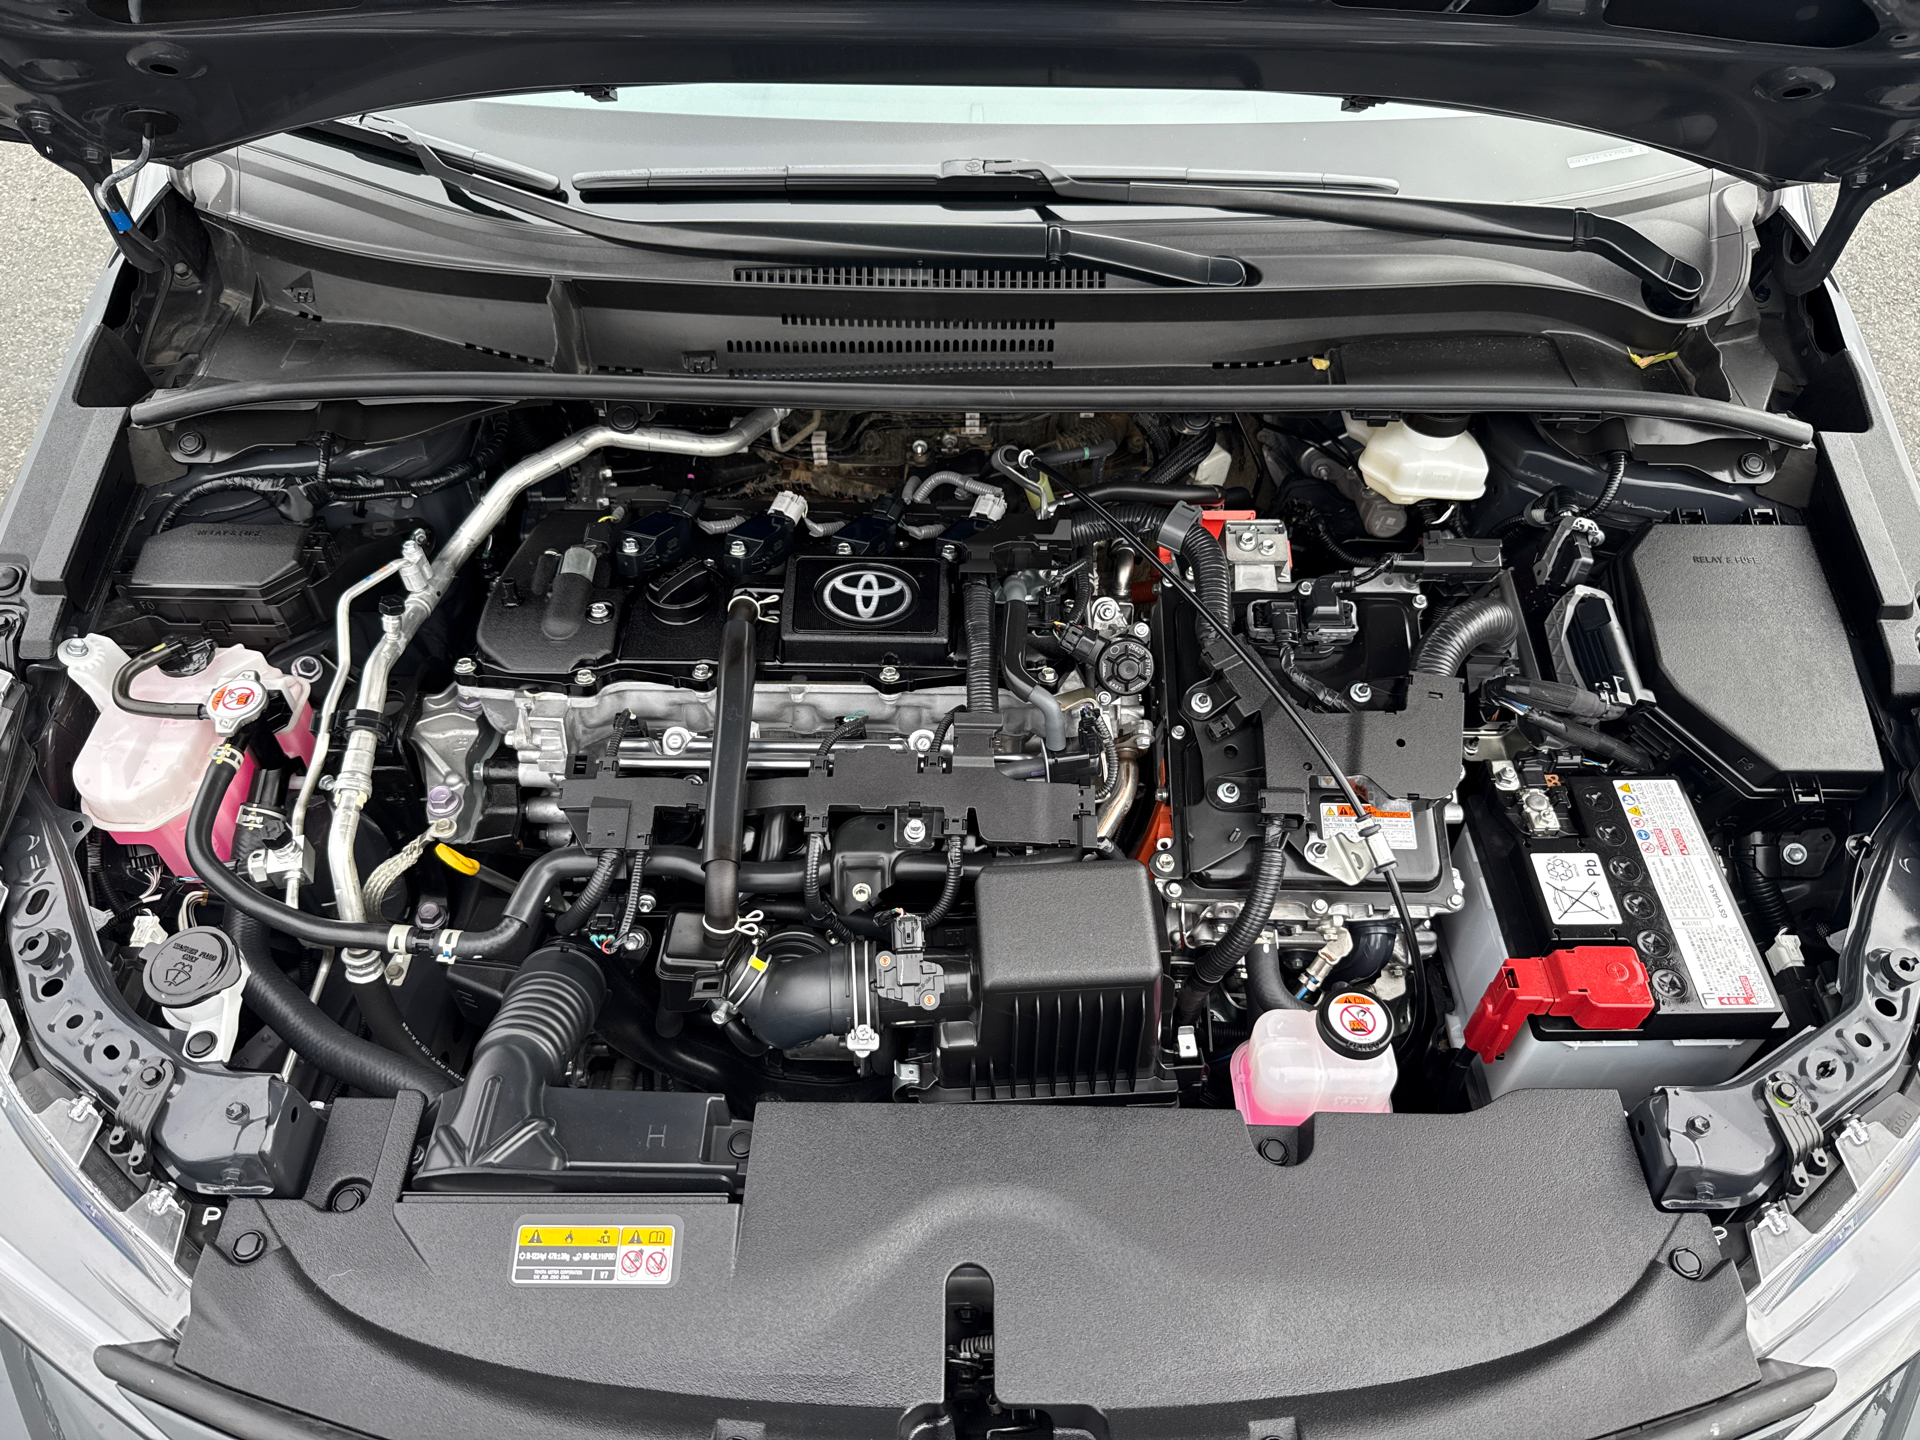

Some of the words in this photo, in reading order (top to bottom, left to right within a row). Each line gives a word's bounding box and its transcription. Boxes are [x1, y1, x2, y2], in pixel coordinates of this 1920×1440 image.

[1128, 644, 1145, 655] 25620
[1130, 682, 1145, 692] TOYOTA
[1737, 757, 1754, 771] F3
[1641, 800, 1659, 826] EXPLOSIVE
[1585, 859, 1600, 876] Pb
[1707, 884, 1723, 908] YUASA
[1718, 909, 1728, 917] GS
[173, 942, 198, 955] WASHER
[199, 952, 217, 962] FLUID
[182, 954, 199, 963] ONLY
[1739, 976, 1754, 996] DANGER
[1346, 1040, 1380, 1051] DENSO
[646, 1124, 667, 1147] H
[202, 1207, 222, 1225] P
